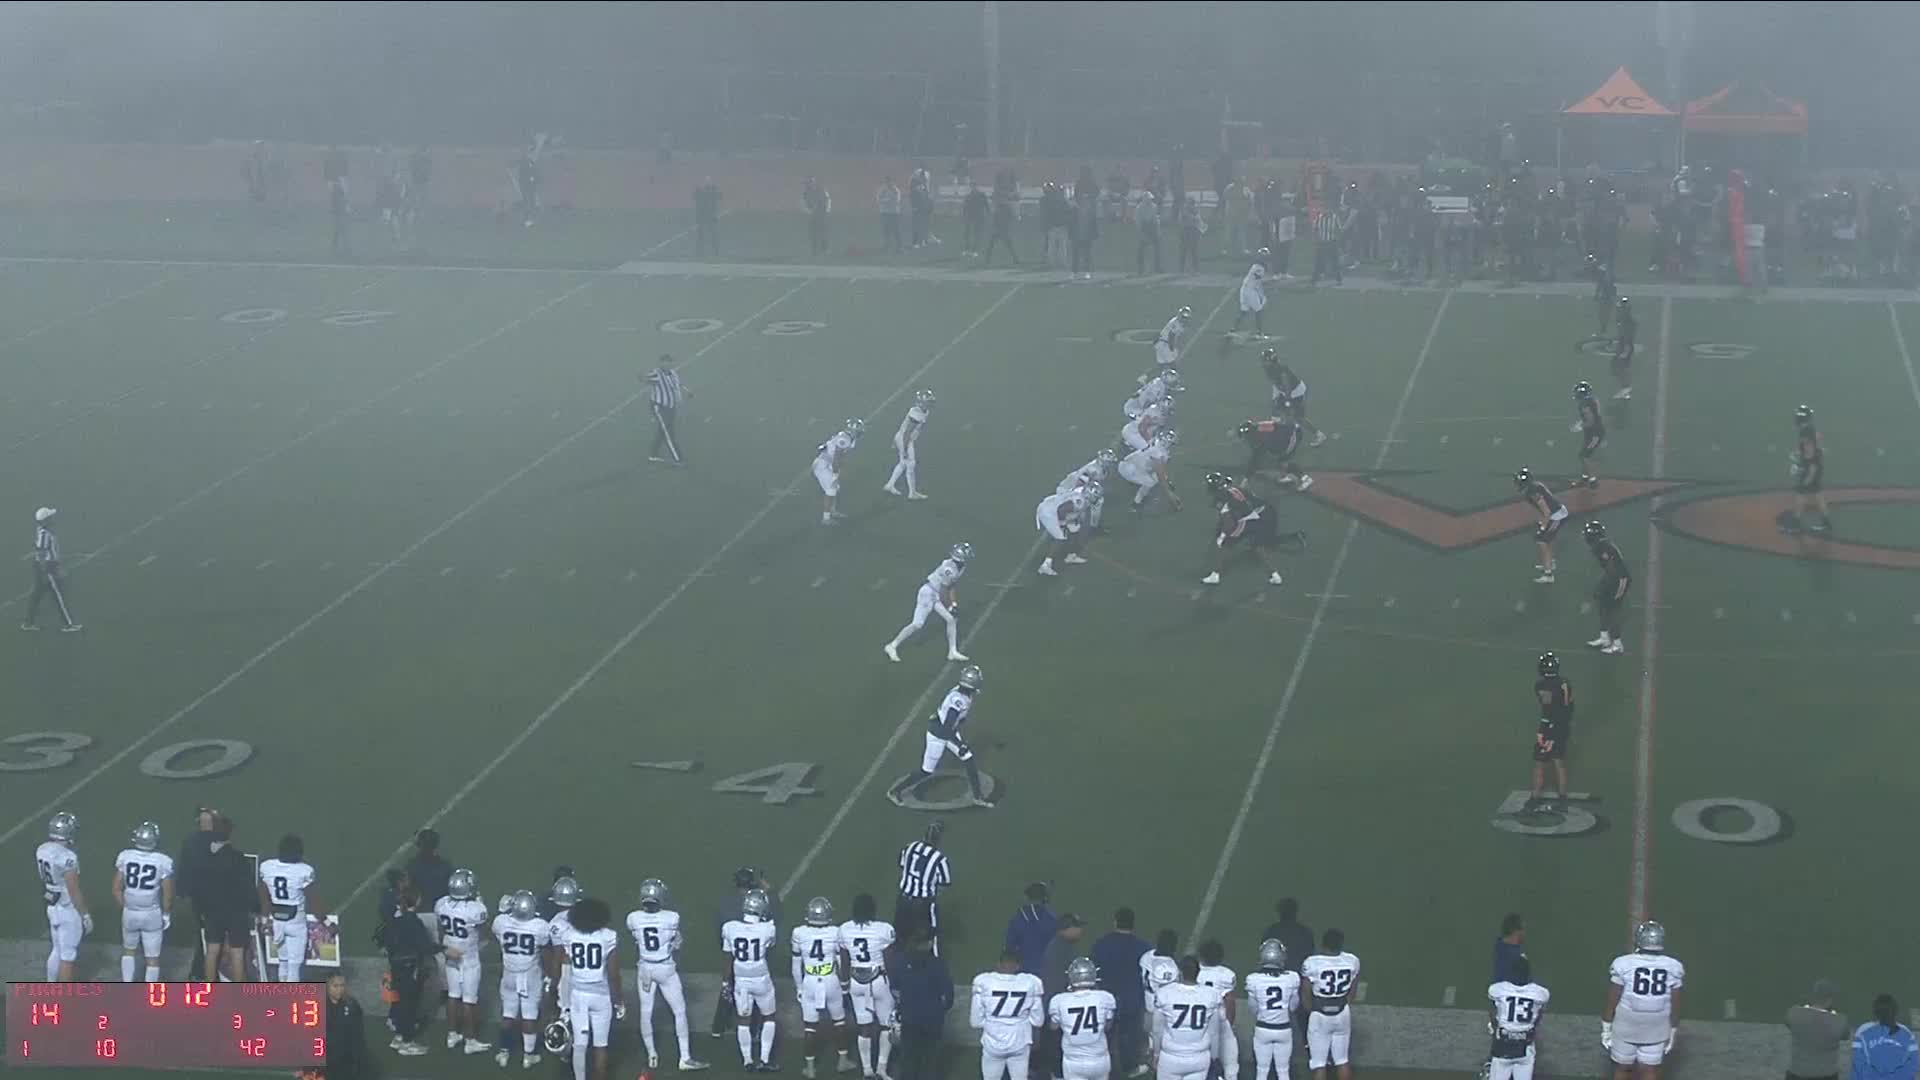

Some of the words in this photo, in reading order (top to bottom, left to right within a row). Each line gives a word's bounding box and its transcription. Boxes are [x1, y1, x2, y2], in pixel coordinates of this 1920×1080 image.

[126, 862, 157, 890] 82
[274, 876, 289, 900] 8
[439, 914, 469, 939] 26
[643, 926, 660, 952] 6
[502, 931, 535, 956] 29
[571, 942, 602, 970] 80
[734, 937, 760, 962] 81
[810, 938, 825, 961] 4
[853, 937, 871, 962] 3
[1319, 968, 1352, 996] 32
[1633, 967, 1668, 996] 68
[991, 990, 1027, 1017] 77
[1266, 986, 1283, 1010] 2
[1506, 996, 1534, 1022] 13
[1067, 1005, 1099, 1036] 74
[1172, 1004, 1207, 1030] 70
